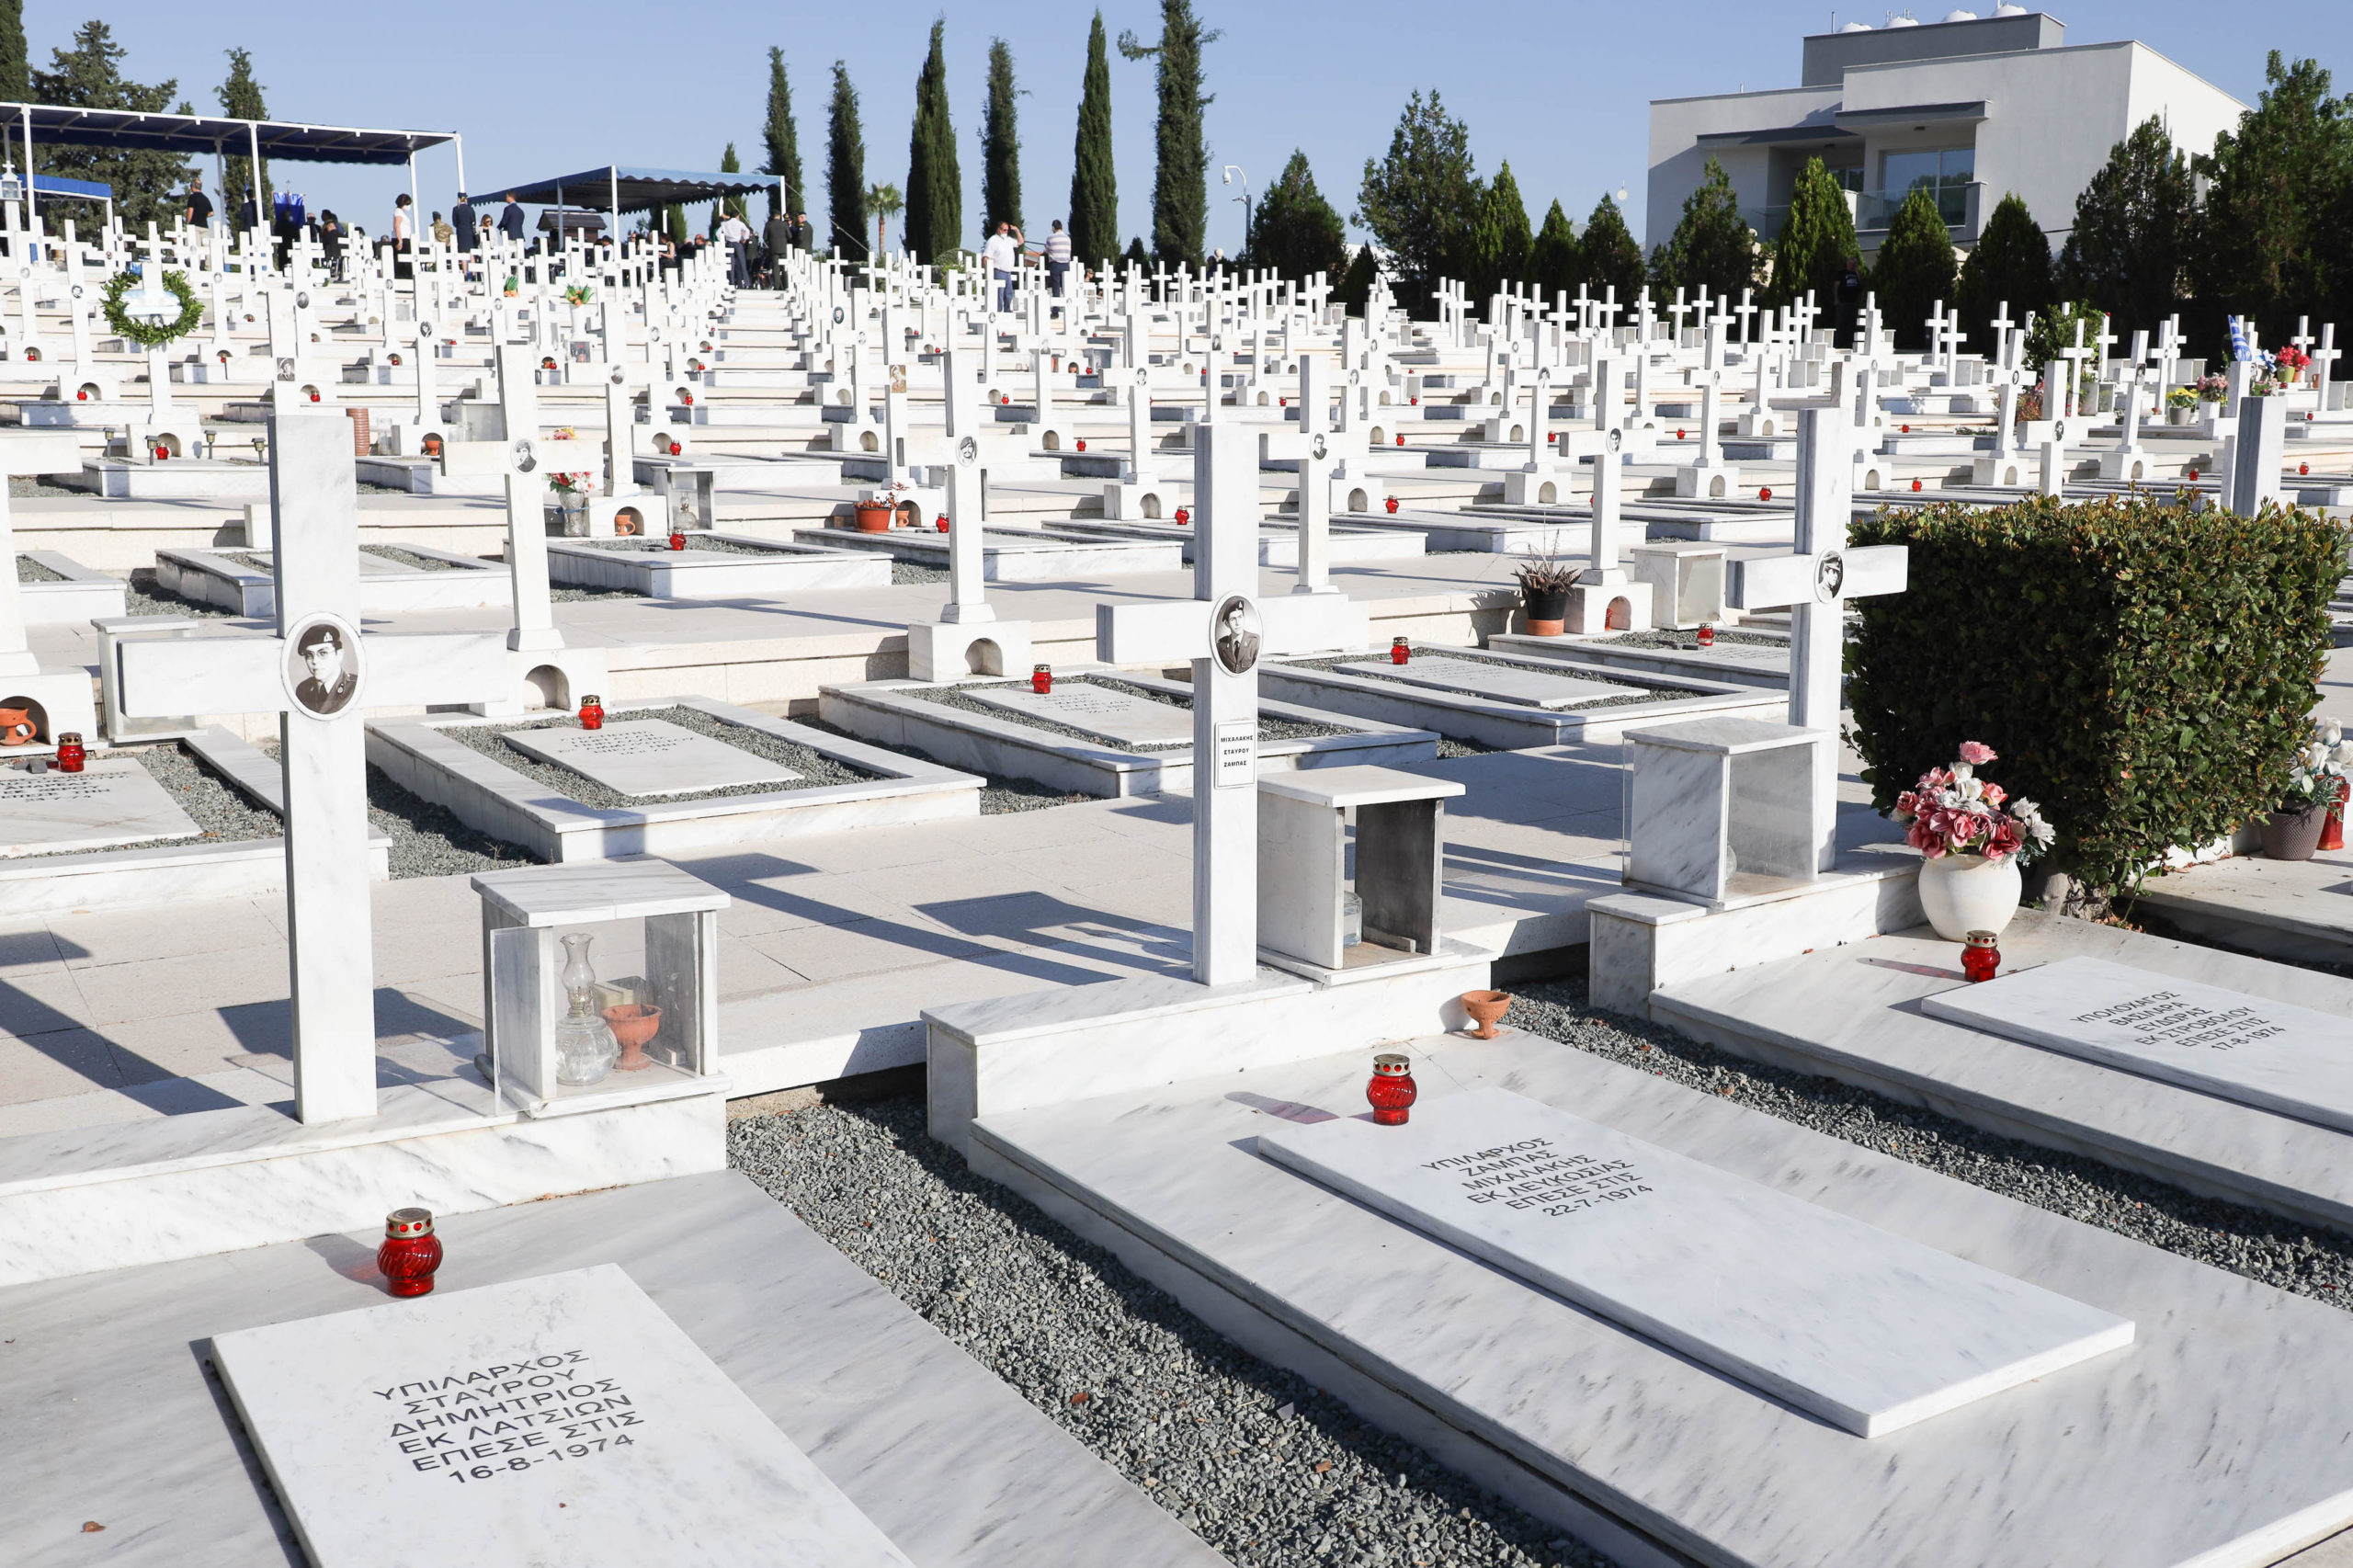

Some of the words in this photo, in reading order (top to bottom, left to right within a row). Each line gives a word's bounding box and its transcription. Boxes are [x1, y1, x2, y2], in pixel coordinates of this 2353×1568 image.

[2069, 991, 2181, 1024] ΥΠΟΛΟΧΑΓΟΣ
[2134, 1034, 2166, 1046] ΕΚ
[2158, 1006, 2256, 1039] ΣΤΡΟΒΟΛΟΥ
[2175, 1028, 2235, 1047] ΕΠΕΣΕ
[2227, 1017, 2269, 1030] ΣΤΙΣ
[2211, 1026, 2286, 1051] 17-8-1974
[1420, 1138, 1553, 1171] ΥΠΙΛΑΡΧΟΣ
[1459, 1150, 1558, 1176] ΖΑΜΠΑΣ
[1461, 1154, 1597, 1190] ΜΙΧΑΛΑΚΗΣ
[1467, 1190, 1508, 1204] ΕΚ
[1507, 1159, 1634, 1196] ΛΕΥΚΩΣΙΑΣ
[1505, 1185, 1590, 1210] ΕΠΕΣΕ
[1586, 1172, 1643, 1189] ΣΤΙΣ
[1542, 1184, 1654, 1217] 22-7-1974
[372, 1349, 589, 1400] ΥΠΙΛΑΡΧΟΣ
[404, 1369, 575, 1415] ΣΤΑΥΡΟΥ
[391, 1378, 621, 1437] ΔΗΜΗΤΡΙΟΣ
[399, 1432, 455, 1454] ΕΚ
[469, 1394, 632, 1440] ΛΑΤΣΙΩΝ
[413, 1432, 550, 1471] ΕΠΕΣΕ
[558, 1411, 644, 1439] ΣΤΙΣ
[449, 1434, 635, 1483] 16-8-1974
